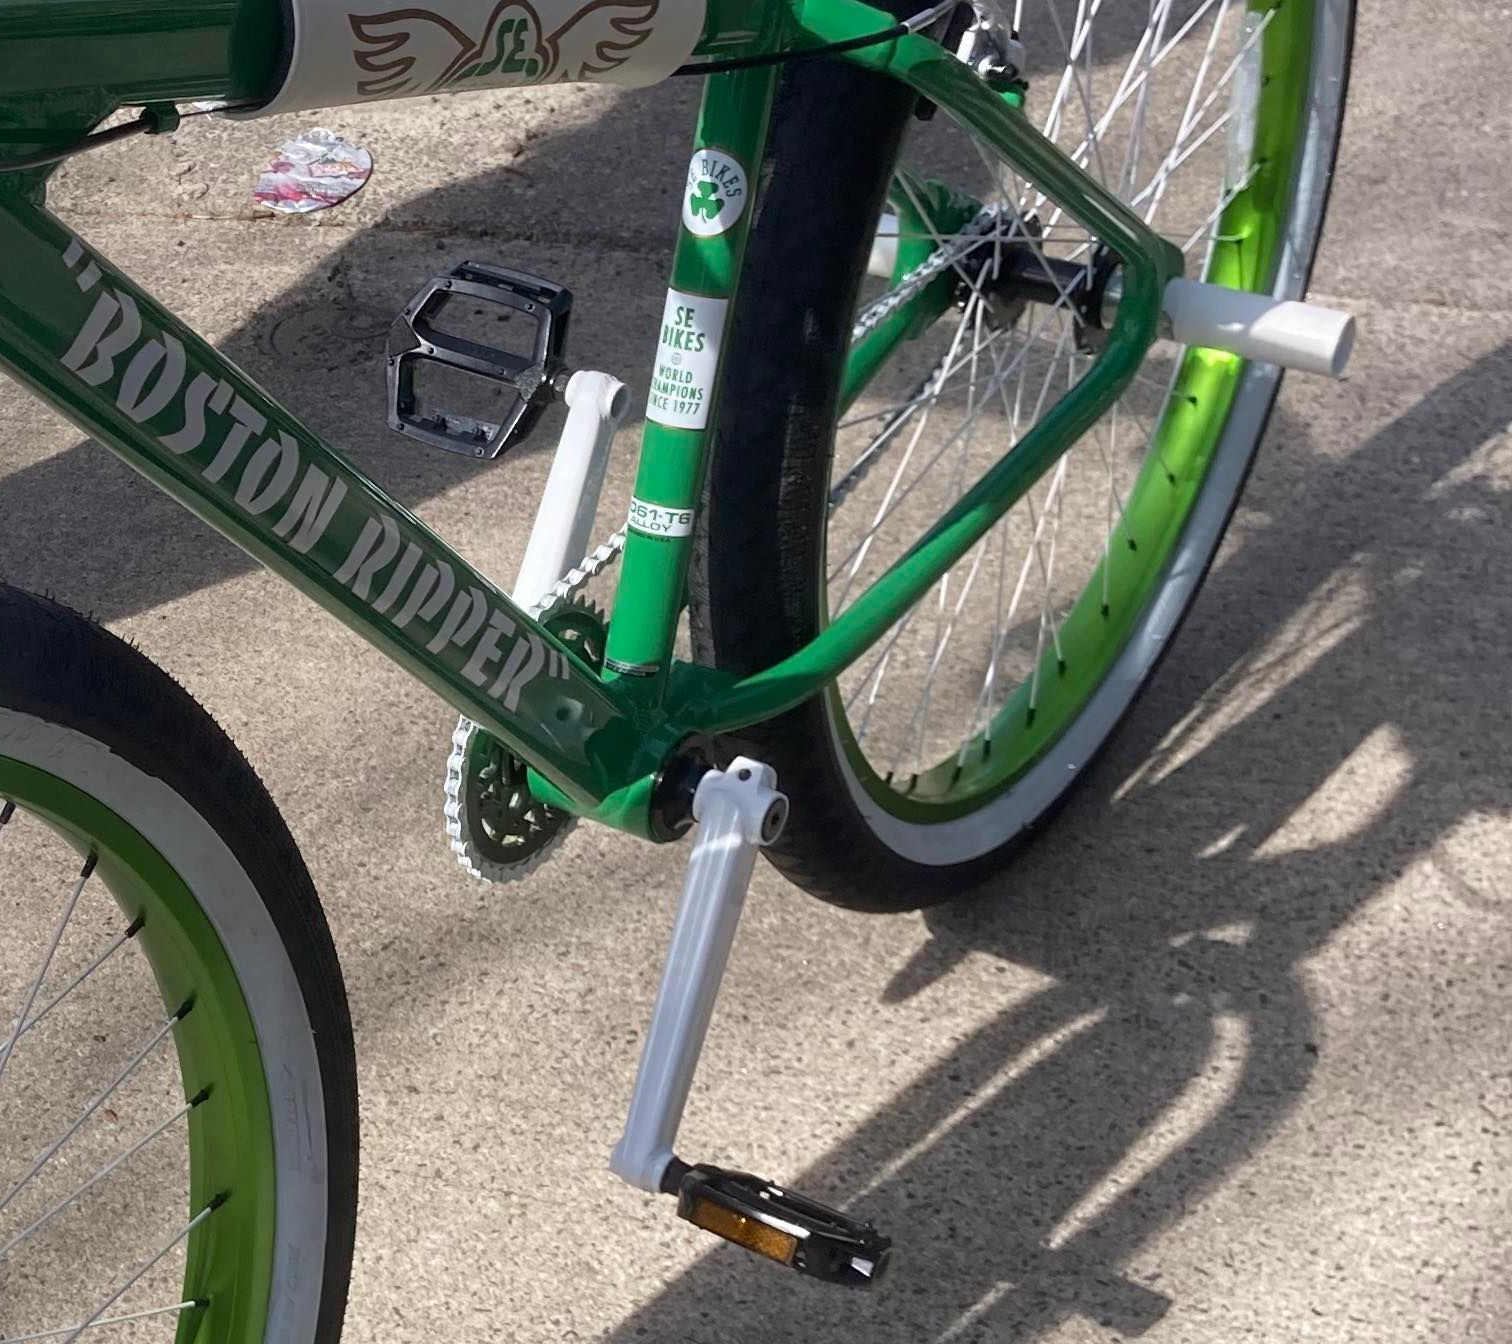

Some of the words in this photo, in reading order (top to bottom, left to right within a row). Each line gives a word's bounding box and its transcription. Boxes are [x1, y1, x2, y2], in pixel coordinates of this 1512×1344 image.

[701, 158, 743, 198] BIKES
[674, 305, 695, 328] SE
[662, 324, 706, 353] BIKES
[658, 363, 693, 384] WORLD
[673, 399, 701, 416] 1977
[631, 515, 672, 533] ALLOY
